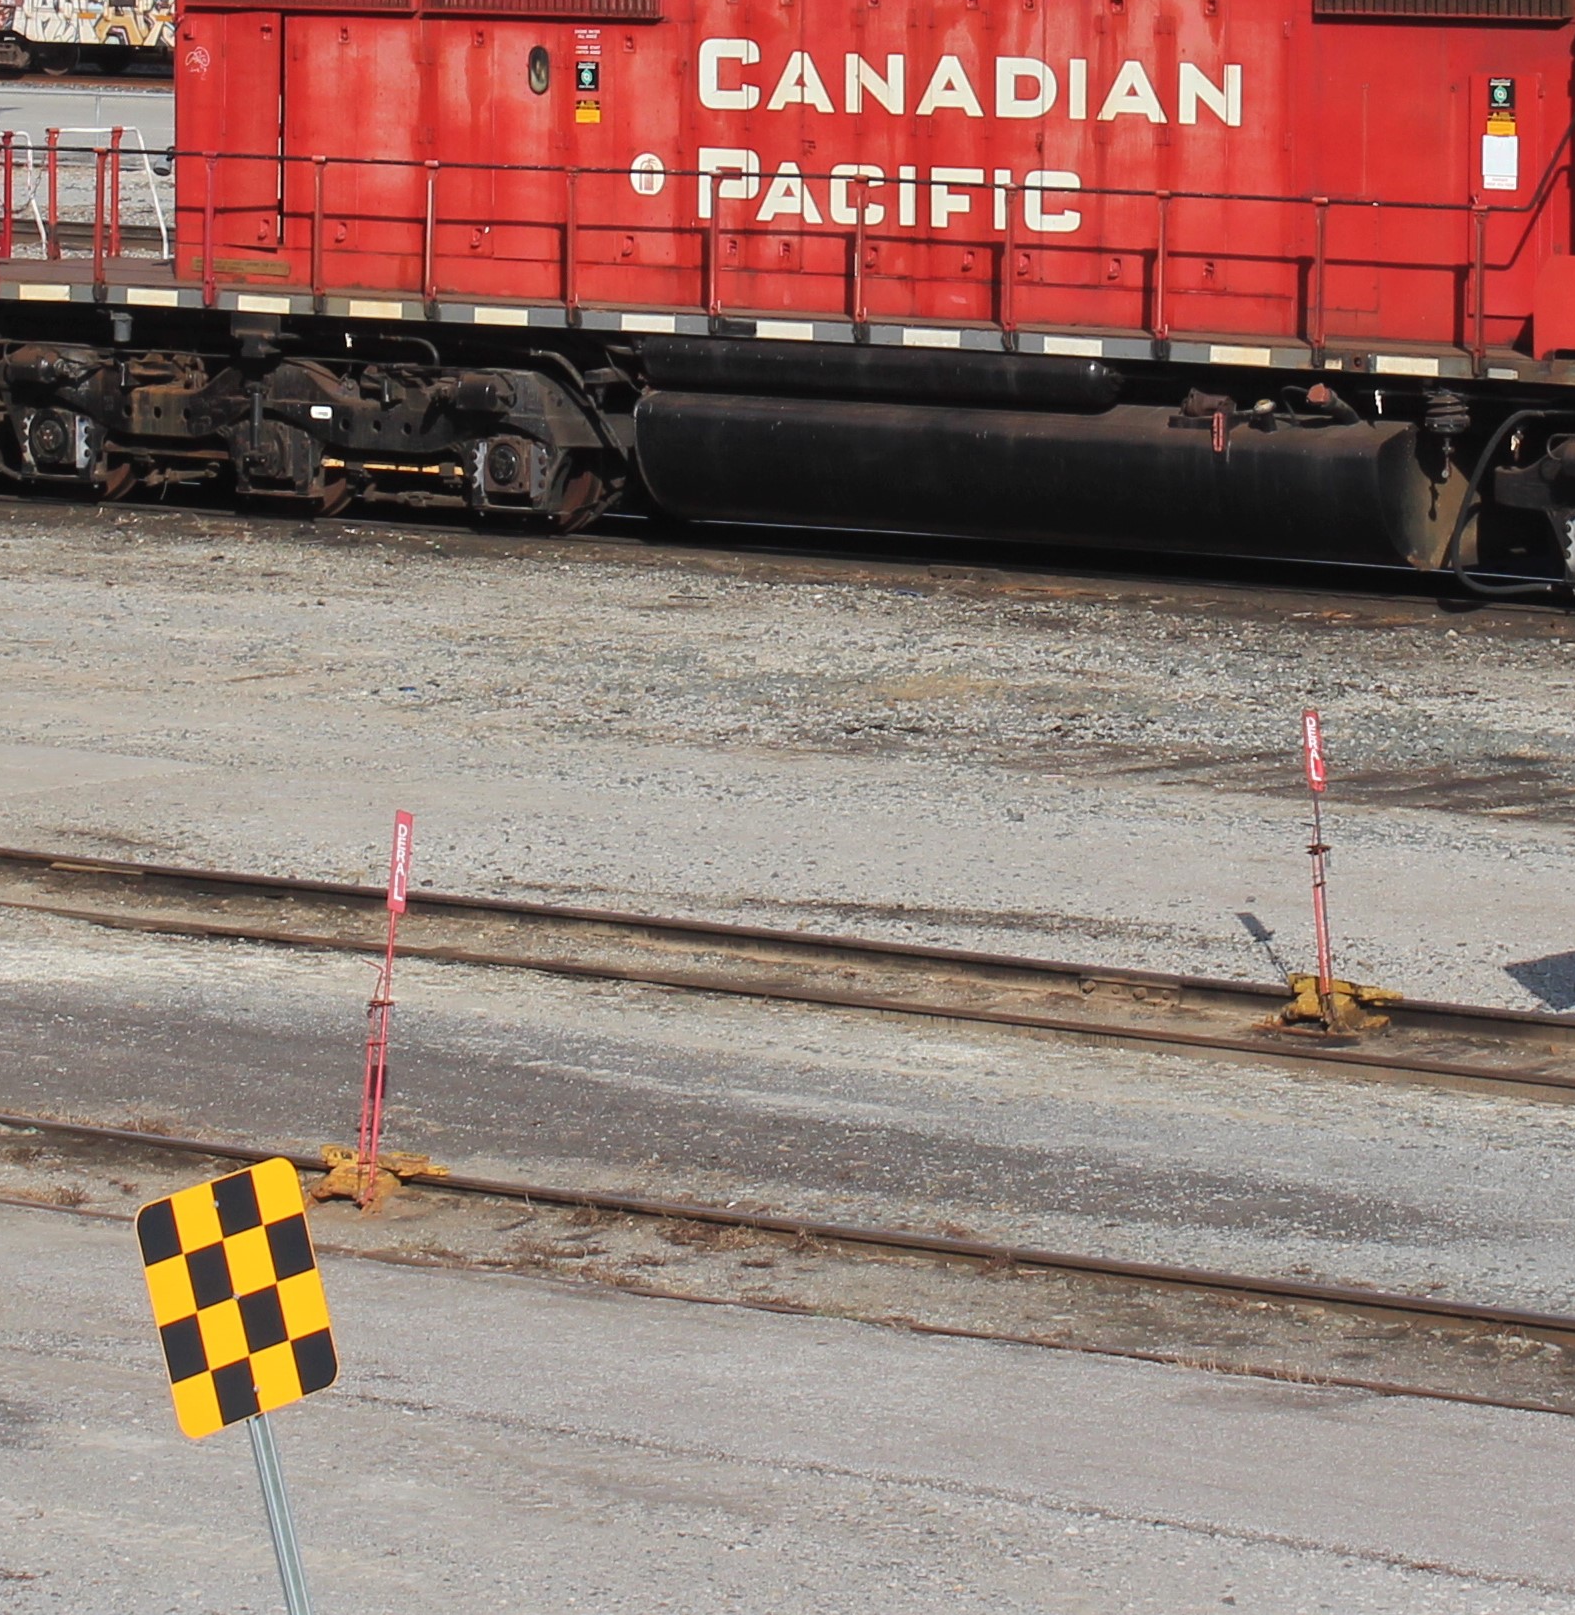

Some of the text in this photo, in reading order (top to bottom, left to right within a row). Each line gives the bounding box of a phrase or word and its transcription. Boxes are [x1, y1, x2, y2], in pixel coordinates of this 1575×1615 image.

[698, 37, 1243, 127] CANADIAN
[697, 147, 1082, 233] PACIFIC
[1306, 716, 1323, 781] DERAIL
[393, 823, 408, 902] DERAIL
